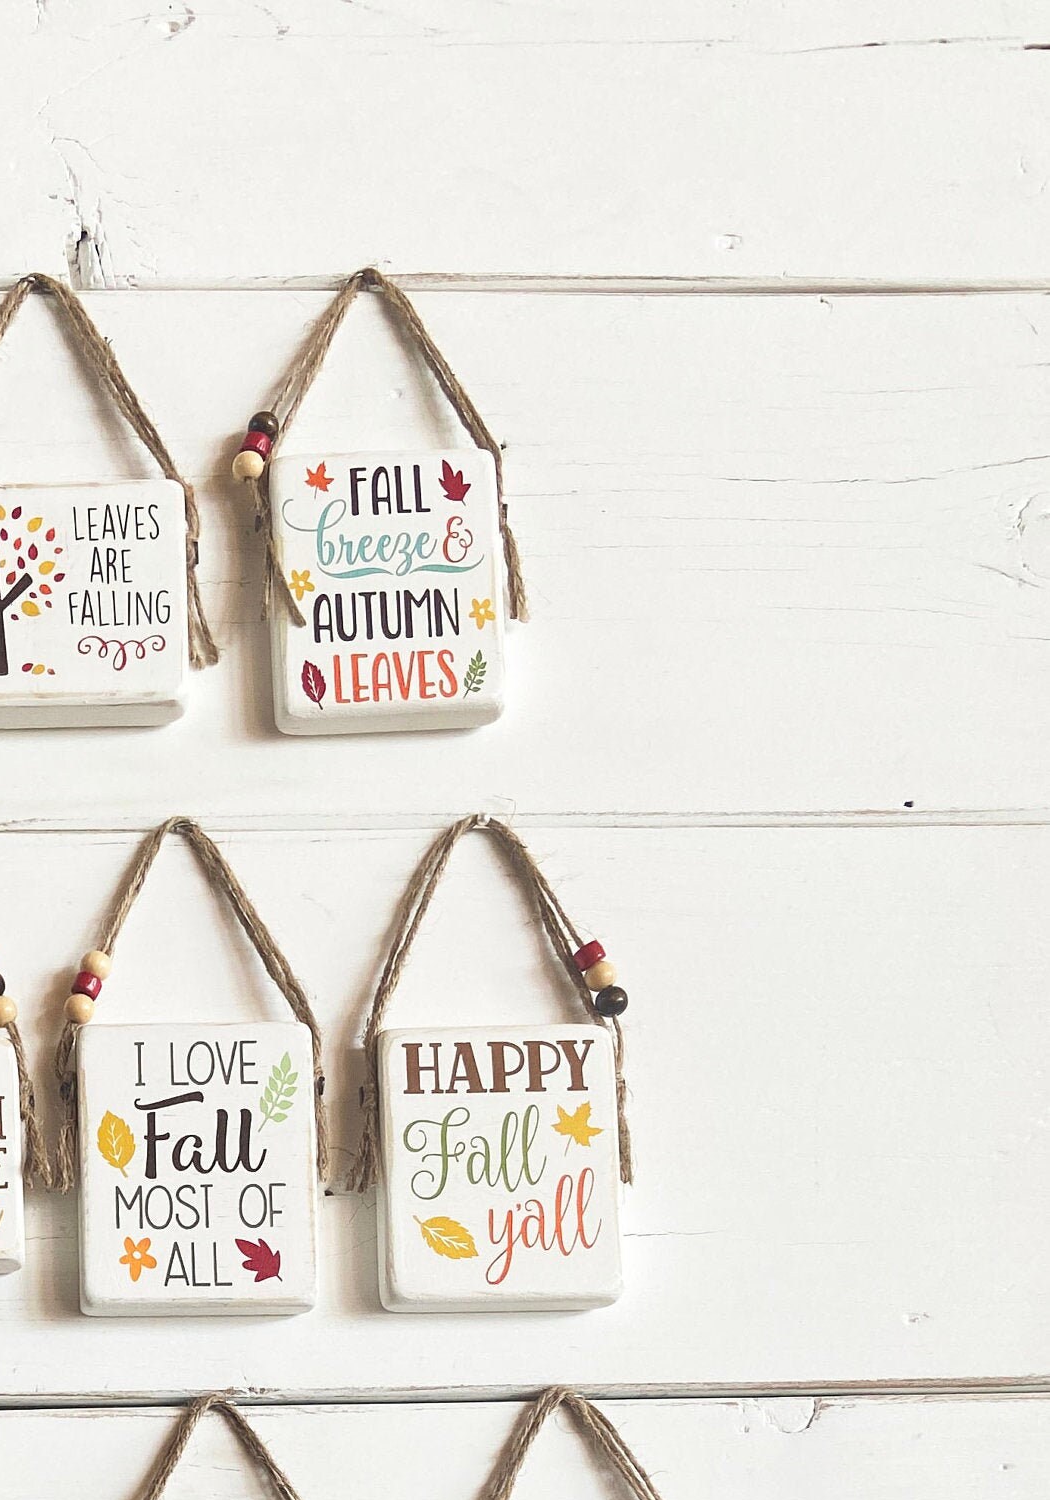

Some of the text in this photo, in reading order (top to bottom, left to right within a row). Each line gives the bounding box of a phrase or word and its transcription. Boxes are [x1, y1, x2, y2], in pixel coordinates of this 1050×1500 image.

[349, 464, 430, 516] FALL
[73, 504, 160, 541] LEAVES
[282, 498, 473, 576] breeze &
[90, 546, 132, 584] ARE
[68, 590, 171, 626] FALLING
[312, 589, 460, 643] AUTUMN
[333, 649, 459, 703] LEAVES
[134, 1040, 258, 1086] I LOVE
[402, 1039, 594, 1095] HAPPY
[133, 1091, 266, 1180] Fall
[403, 1104, 547, 1200] Fall
[115, 1183, 286, 1230] MOST OF
[484, 1167, 602, 1285] y'all
[163, 1242, 233, 1287] ALL
